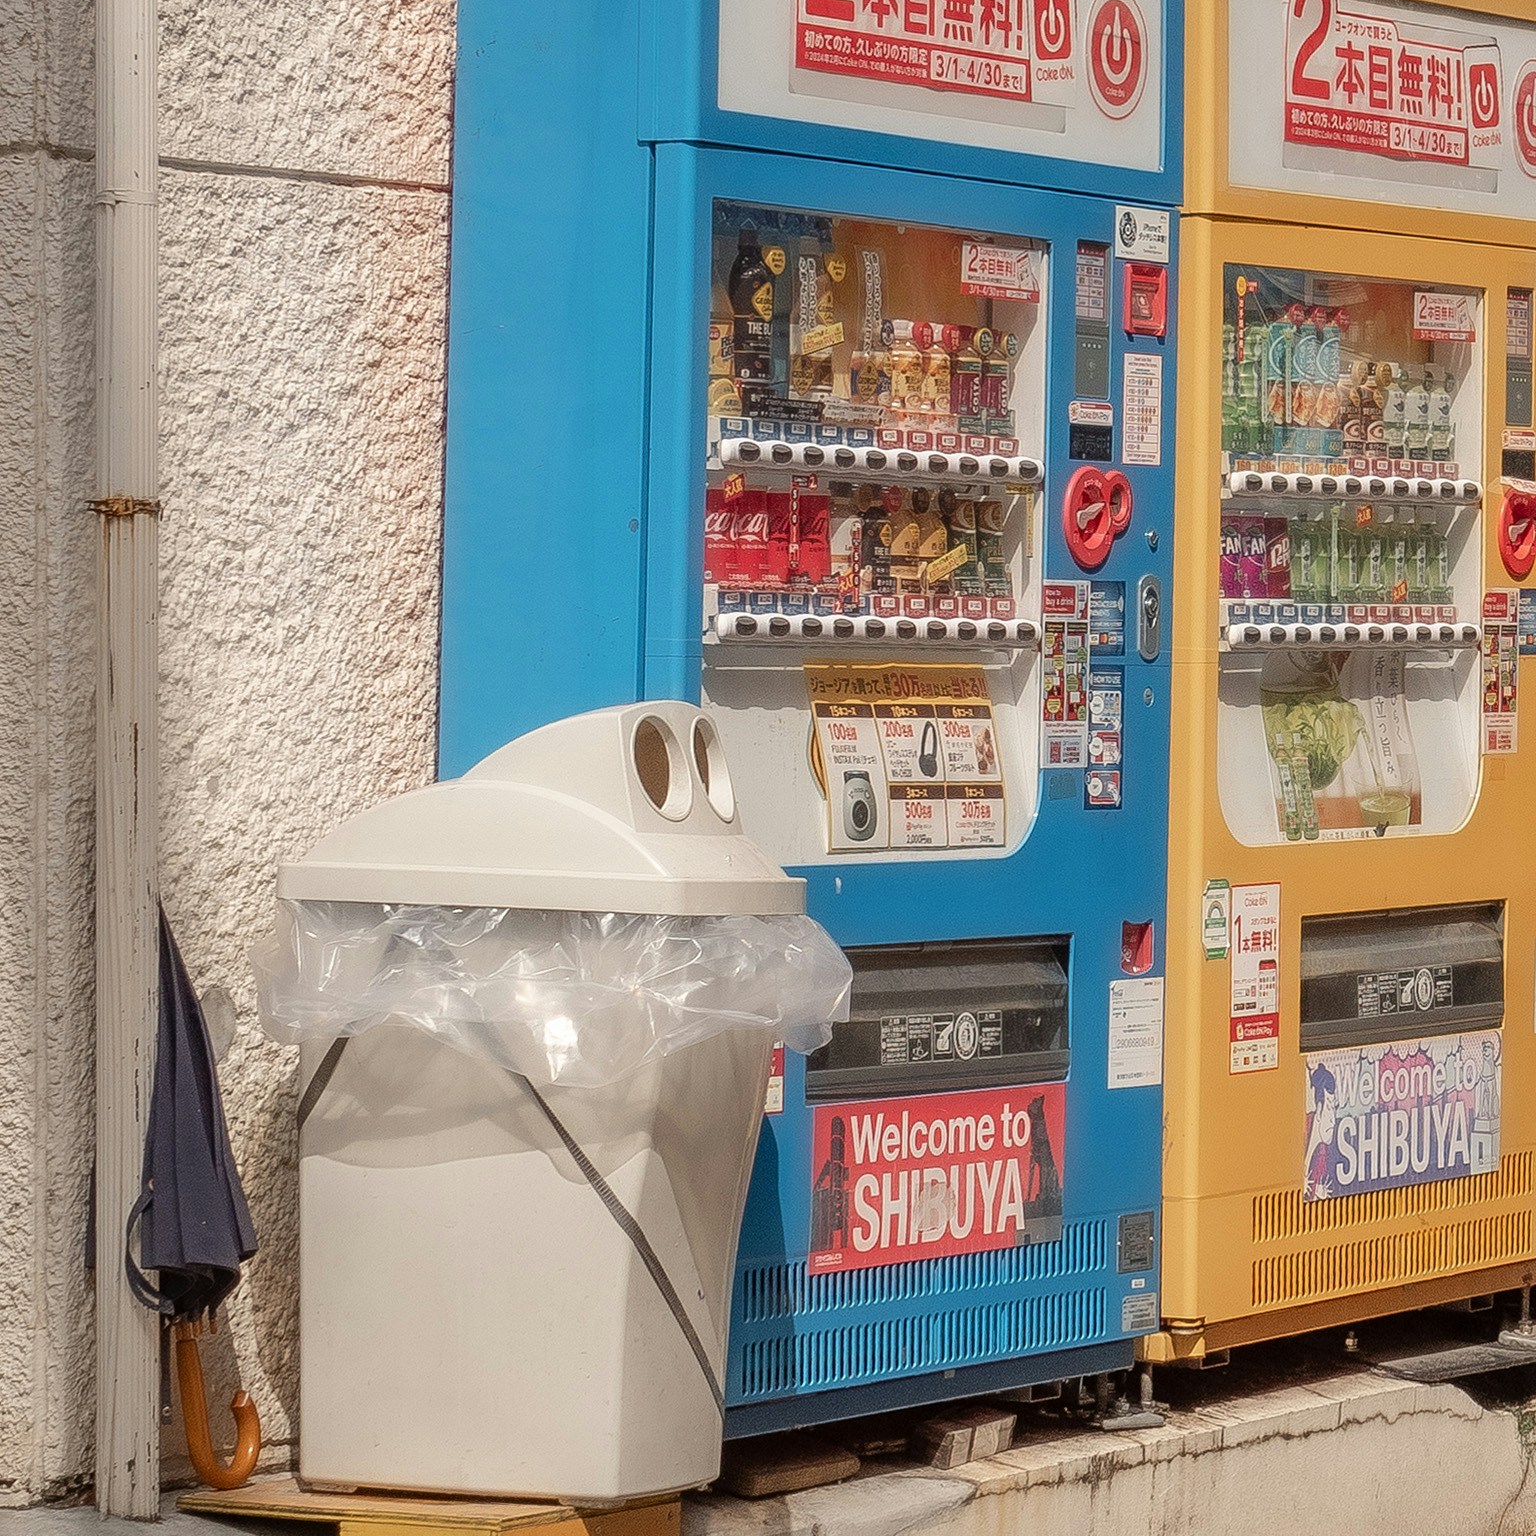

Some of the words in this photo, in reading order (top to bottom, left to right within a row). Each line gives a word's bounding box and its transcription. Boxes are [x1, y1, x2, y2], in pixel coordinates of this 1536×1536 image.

[804, 30, 928, 63] 初めての方、久しぶりの方限定
[1000, 379, 1008, 415] COSTA
[1334, 1061, 1454, 1109] Welcome
[1455, 1056, 1478, 1094] to
[850, 1107, 996, 1165] Welcome
[1000, 1102, 1032, 1148] to
[1336, 1101, 1471, 1186] SHIBUYA
[852, 1158, 1027, 1253] SHIBUYA
